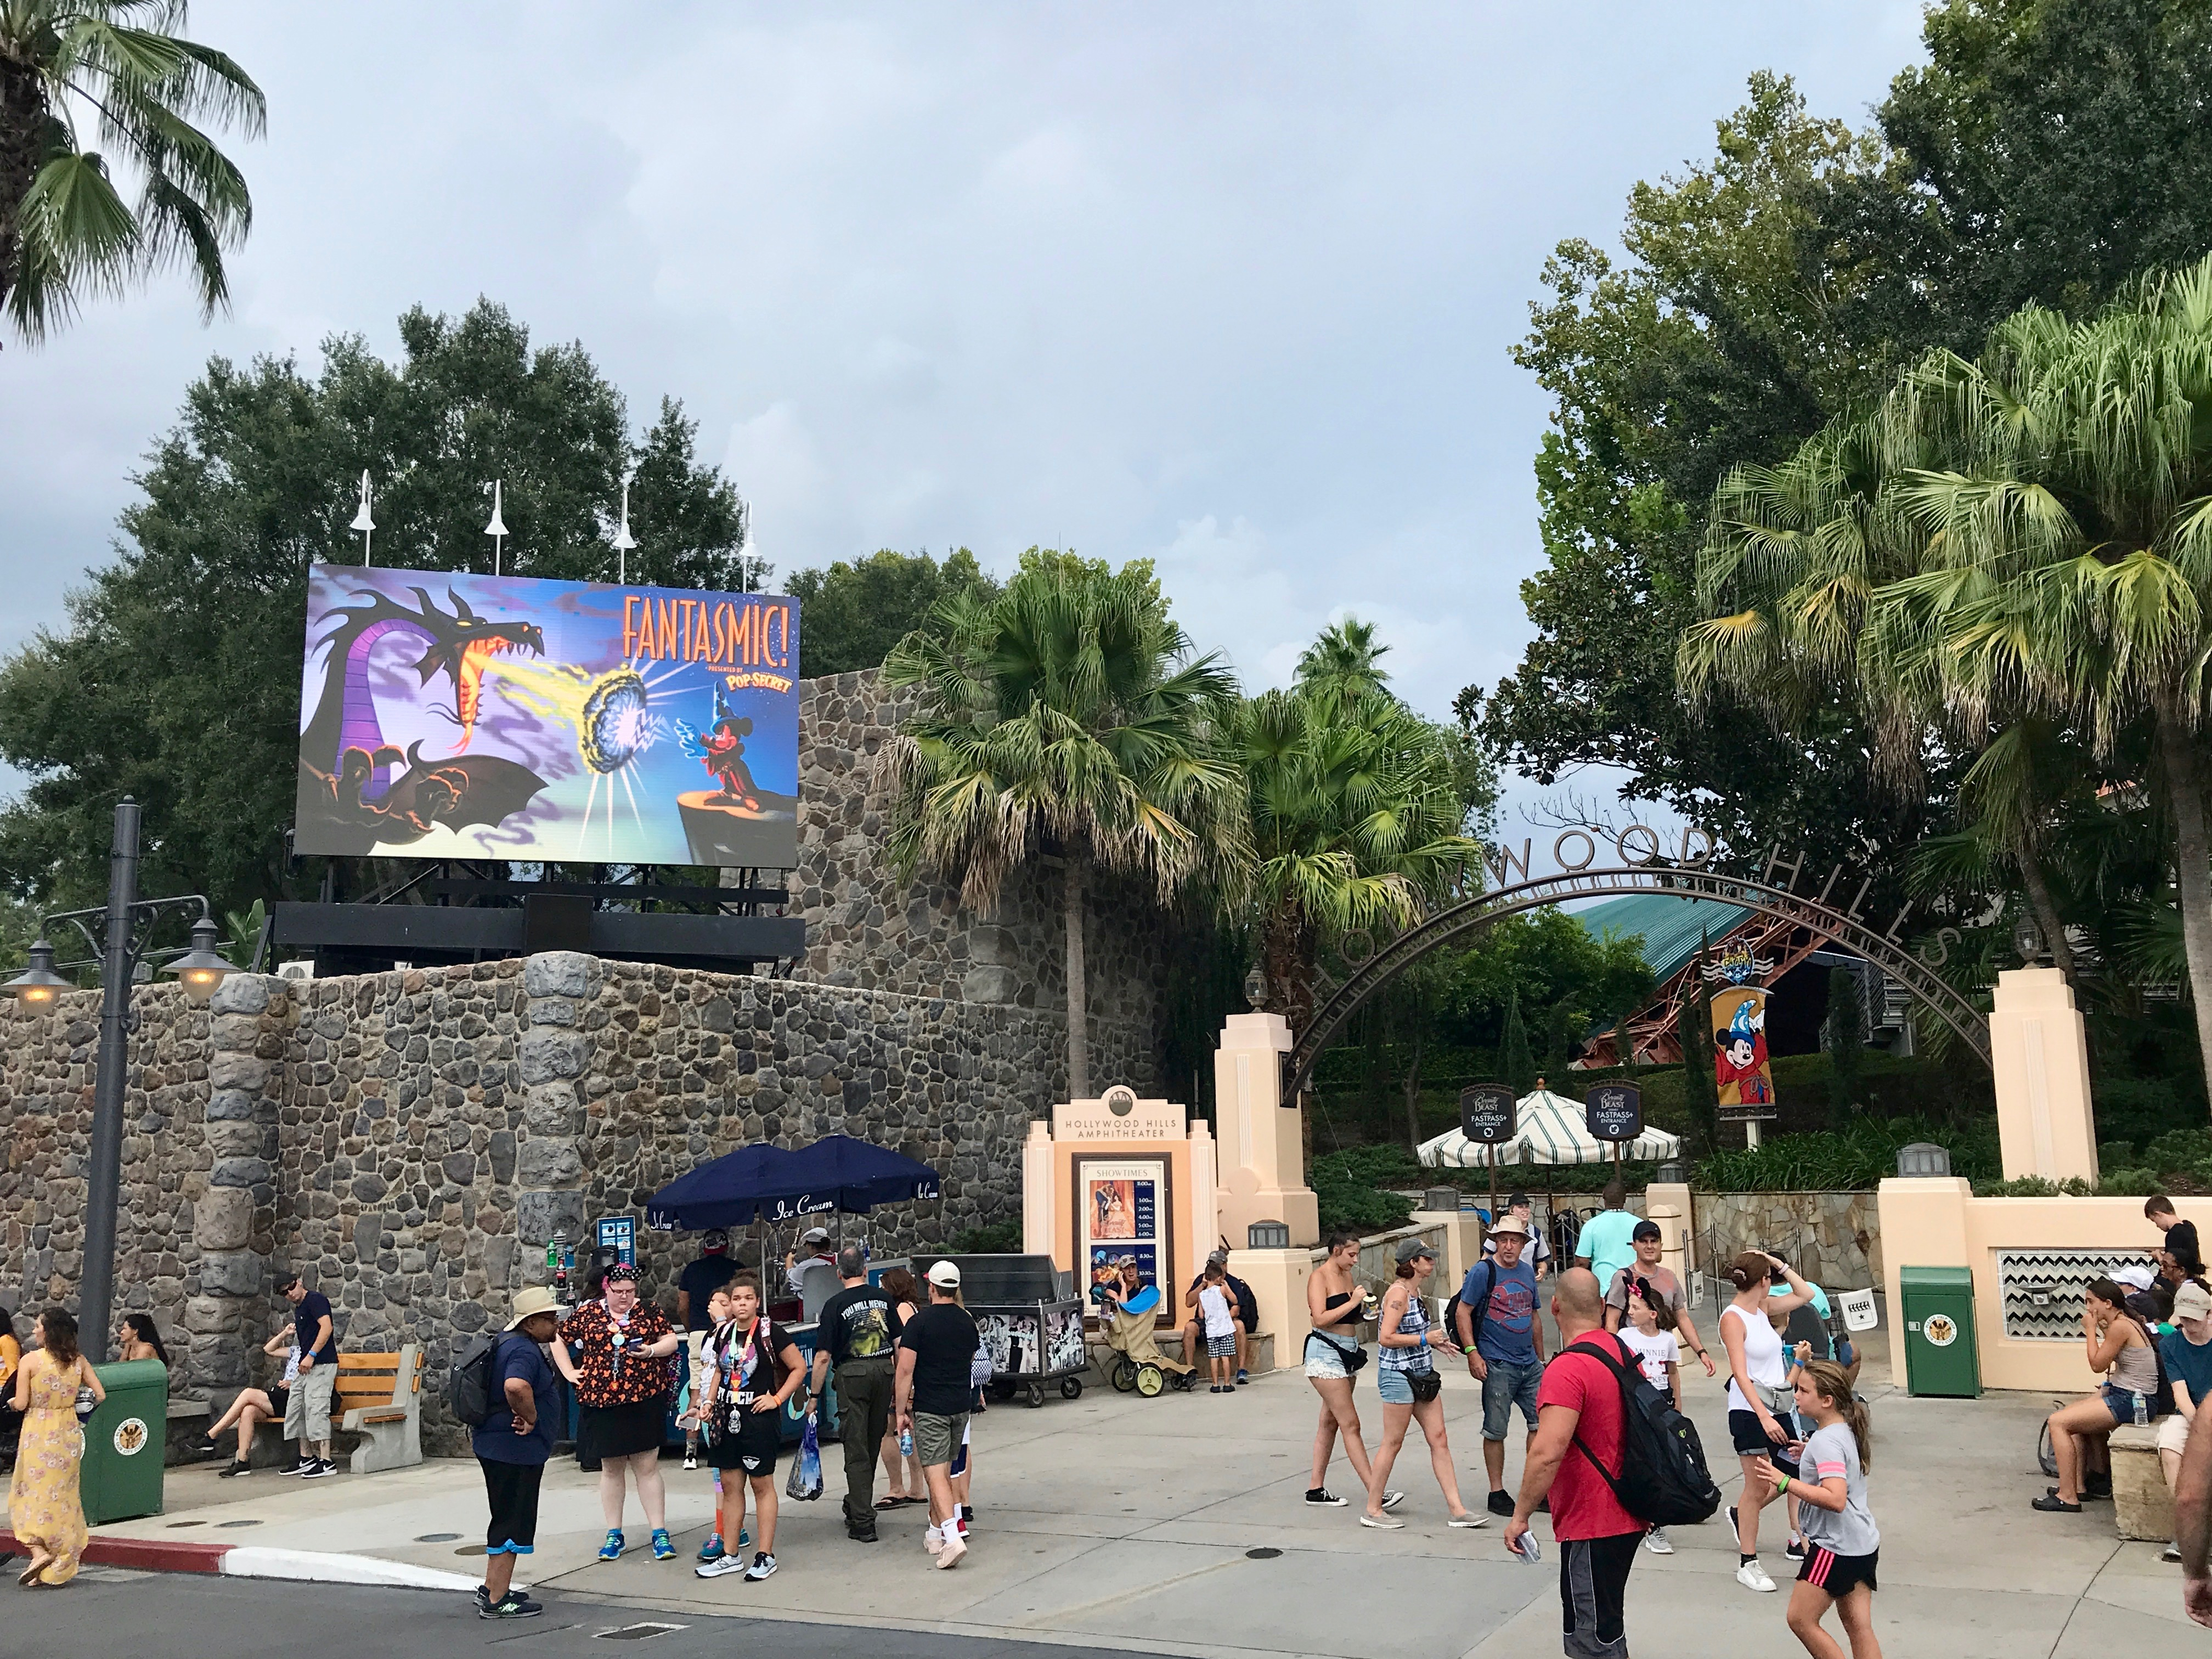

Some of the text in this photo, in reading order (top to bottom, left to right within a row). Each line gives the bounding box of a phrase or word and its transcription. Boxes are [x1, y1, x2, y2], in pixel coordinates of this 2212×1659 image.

[623, 595, 789, 668] FANTASMIC!
[1763, 843, 1962, 967] HILLS
[1066, 1120, 1139, 1128] HOLLYWOOD
[1078, 1130, 1165, 1138] AMPHITHEATER
[1097, 1169, 1148, 1177] SHOWTIMES
[772, 1194, 833, 1221] Ice Cream
[841, 1304, 854, 1320] YOU
[853, 1300, 869, 1312] WILL
[868, 1300, 888, 1310] NEVER
[1635, 1347, 1666, 1356] MINNIE
